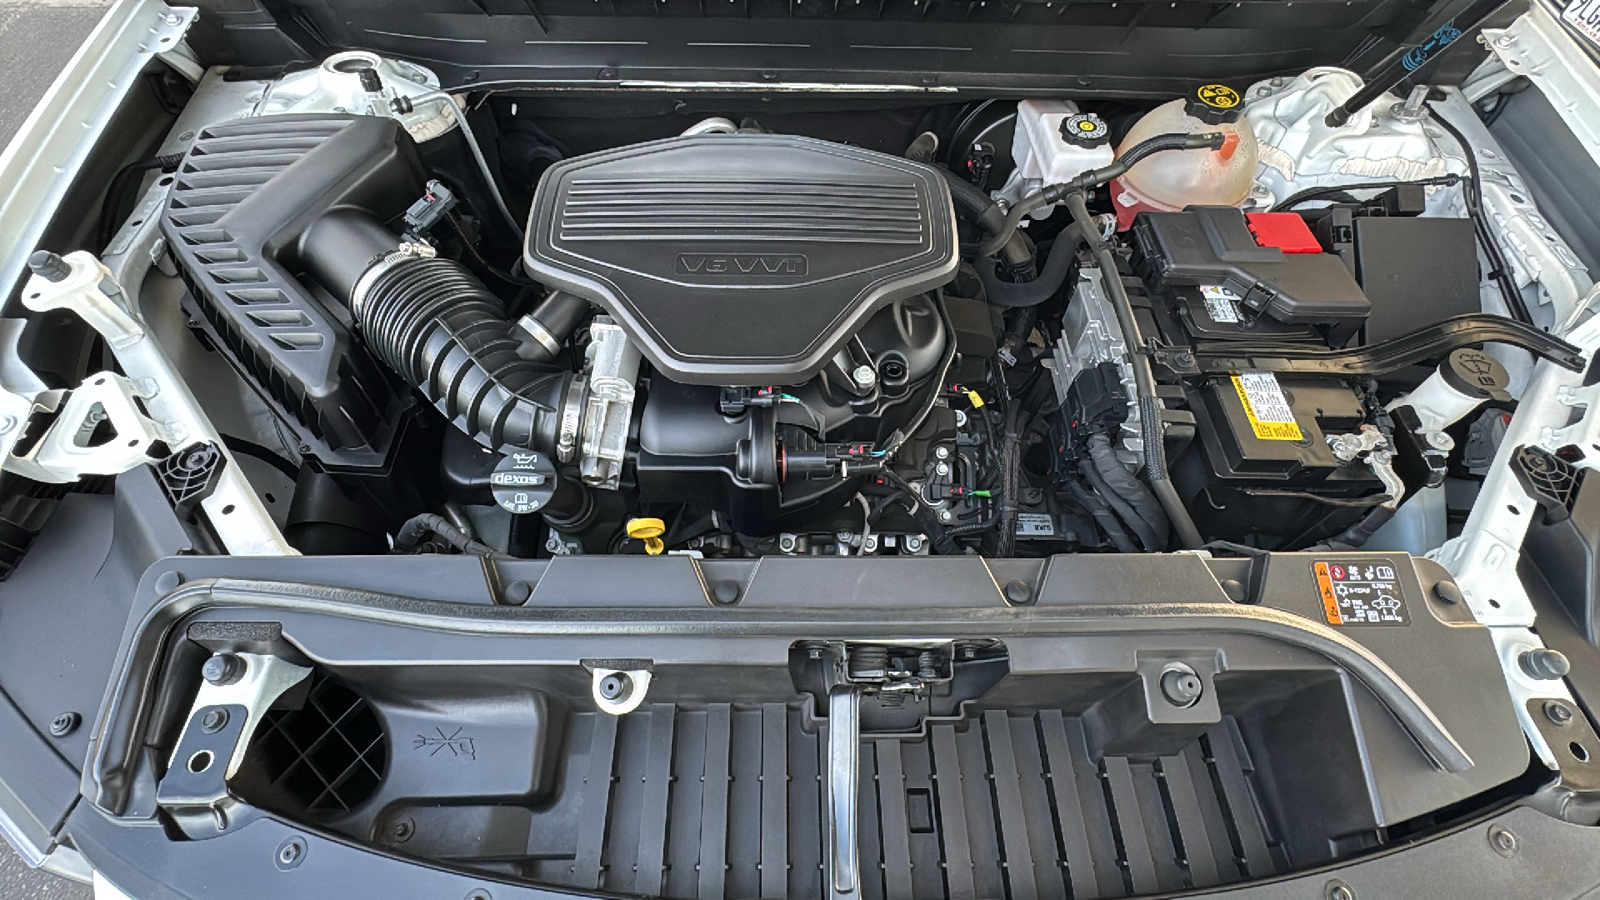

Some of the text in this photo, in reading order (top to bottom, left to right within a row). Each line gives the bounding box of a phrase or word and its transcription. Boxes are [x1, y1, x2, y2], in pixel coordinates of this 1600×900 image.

[681, 257, 803, 273] V6 VVT
[494, 473, 539, 484] dexos
